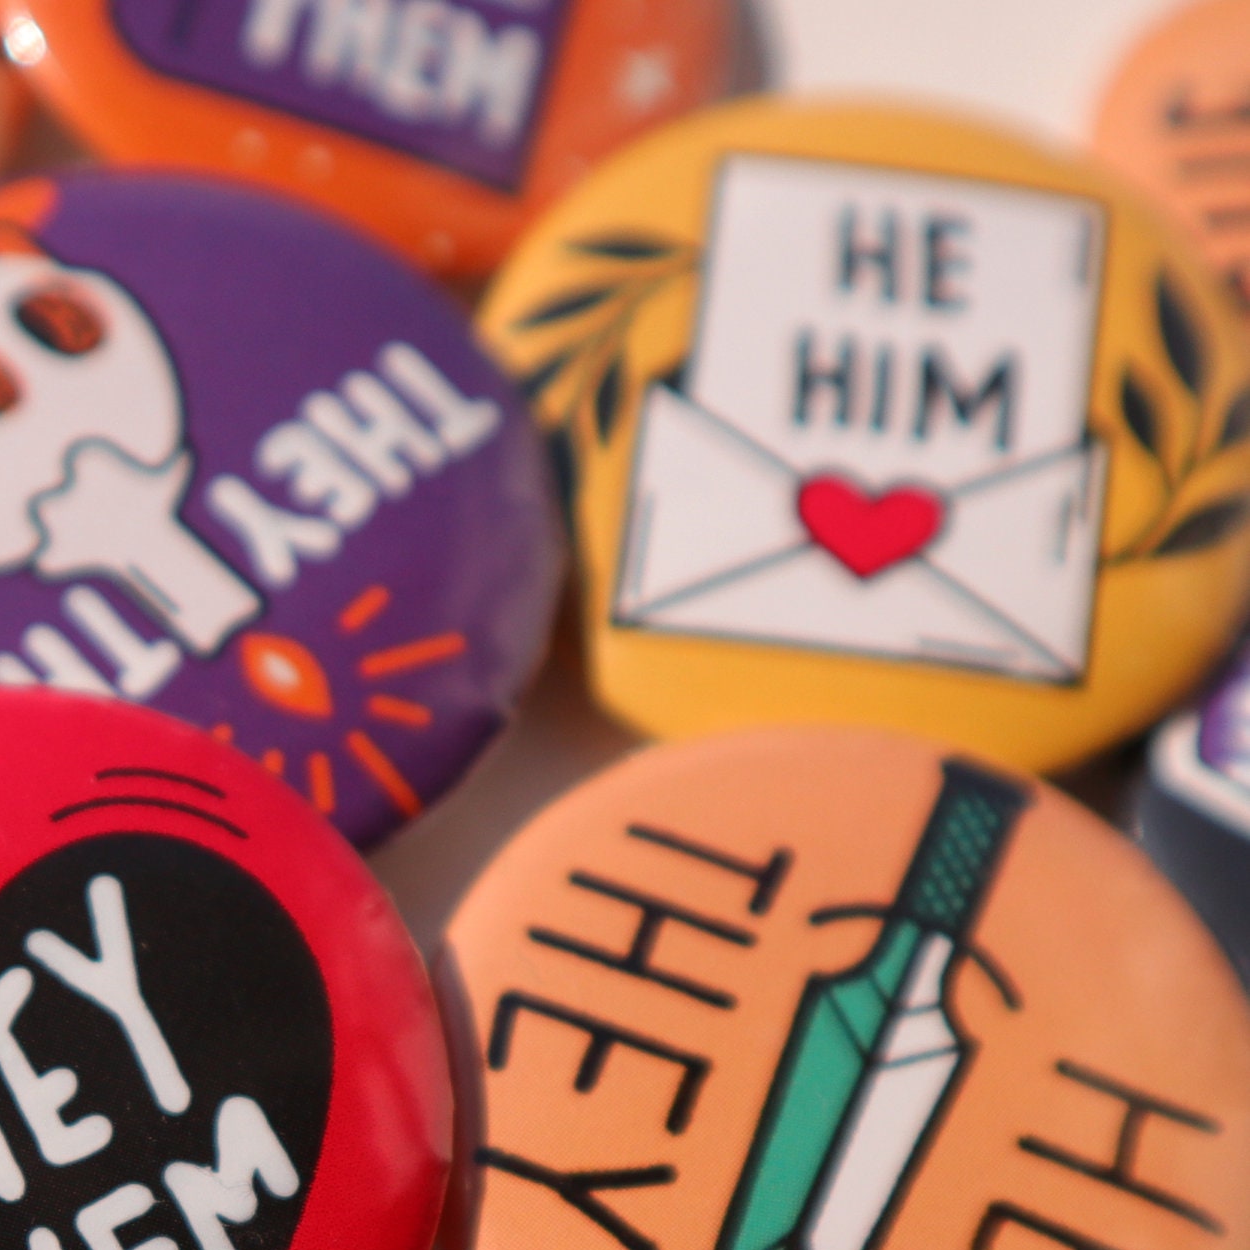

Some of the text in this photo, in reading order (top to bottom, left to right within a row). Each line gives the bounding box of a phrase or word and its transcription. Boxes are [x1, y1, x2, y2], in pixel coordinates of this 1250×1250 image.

[834, 200, 972, 311] HE
[789, 326, 1020, 458] HIM
[208, 341, 501, 587] THEY
